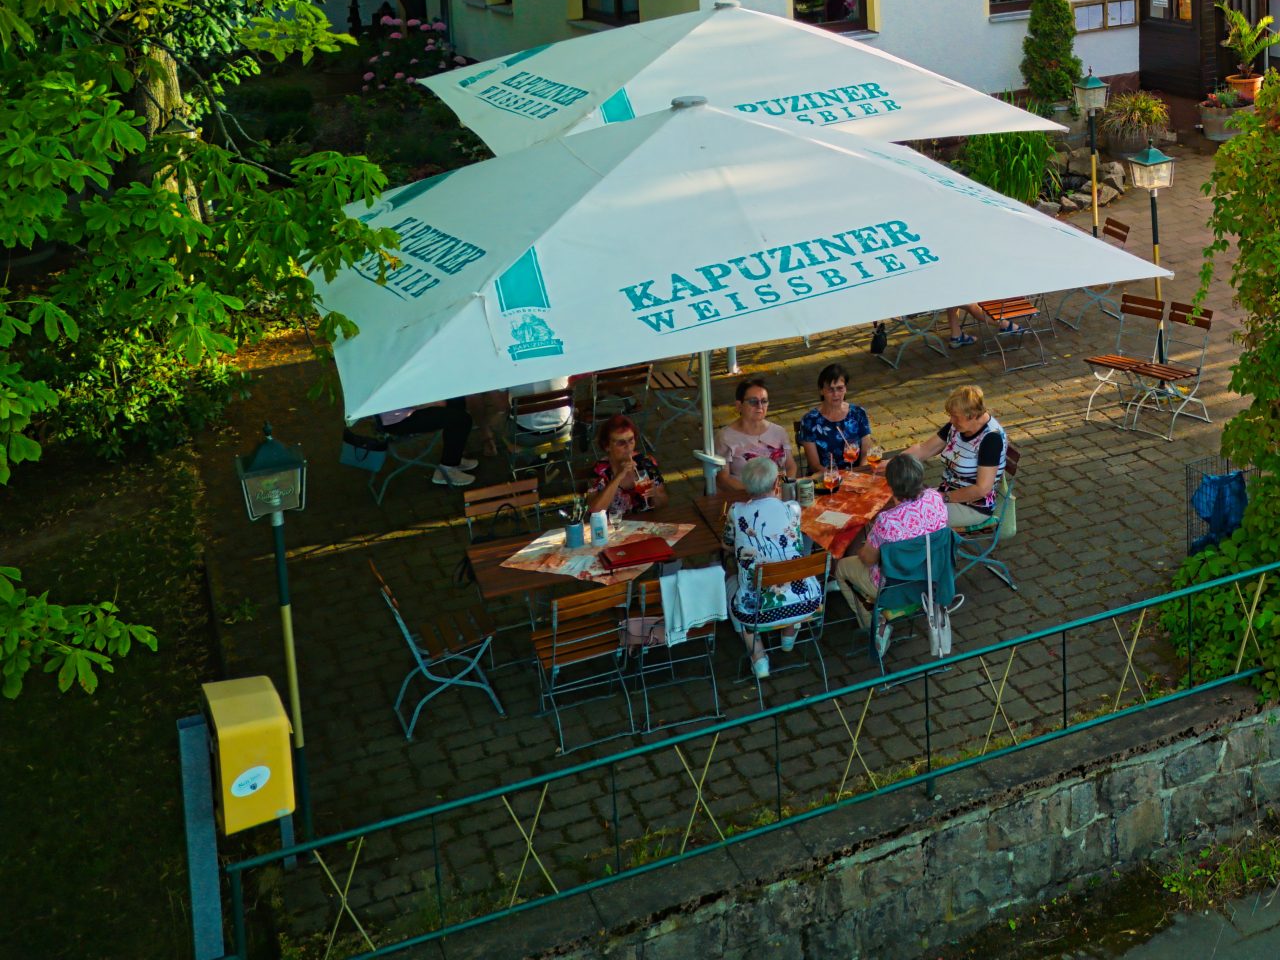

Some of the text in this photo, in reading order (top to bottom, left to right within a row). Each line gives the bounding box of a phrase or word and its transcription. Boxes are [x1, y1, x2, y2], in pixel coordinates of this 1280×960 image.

[479, 85, 559, 120] WEISSBIER
[501, 71, 589, 107] KAPUZINER
[733, 81, 890, 116] PUZINER
[796, 98, 902, 125] SBIER
[618, 219, 921, 312] KAPUZINER
[637, 245, 939, 333] WEISSBIER
